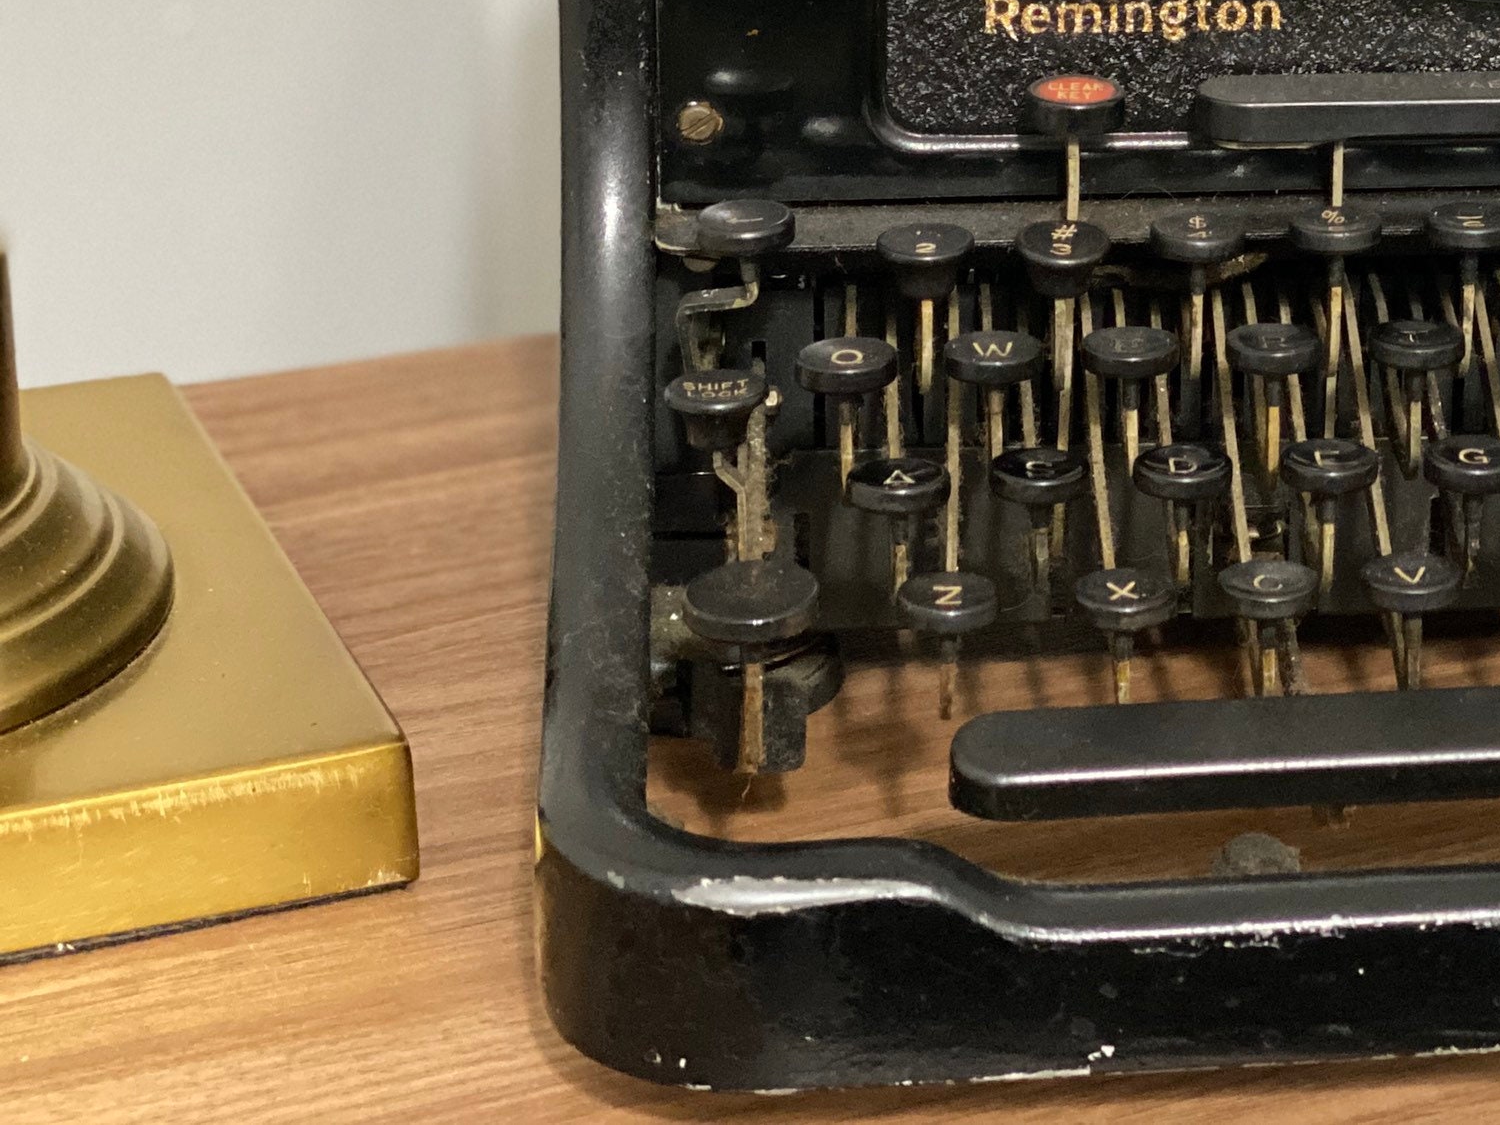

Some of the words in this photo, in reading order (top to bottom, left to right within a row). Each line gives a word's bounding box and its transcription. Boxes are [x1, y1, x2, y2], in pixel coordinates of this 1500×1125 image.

[1047, 81, 1105, 92] CLEAR
[1056, 90, 1092, 100] KEY
[1188, 215, 1207, 230] $
[1321, 209, 1346, 225] %
[1050, 223, 1078, 240] #
[914, 242, 938, 255] 2
[1050, 243, 1073, 256] 3
[971, 341, 1013, 357] W
[682, 378, 750, 392] SHIFT
[686, 388, 748, 398] LOCK
[1458, 448, 1490, 465] G
[1168, 457, 1198, 474] D
[882, 469, 916, 485] A
[1393, 566, 1427, 584] V
[932, 585, 963, 606] Z
[1105, 580, 1140, 601] X
